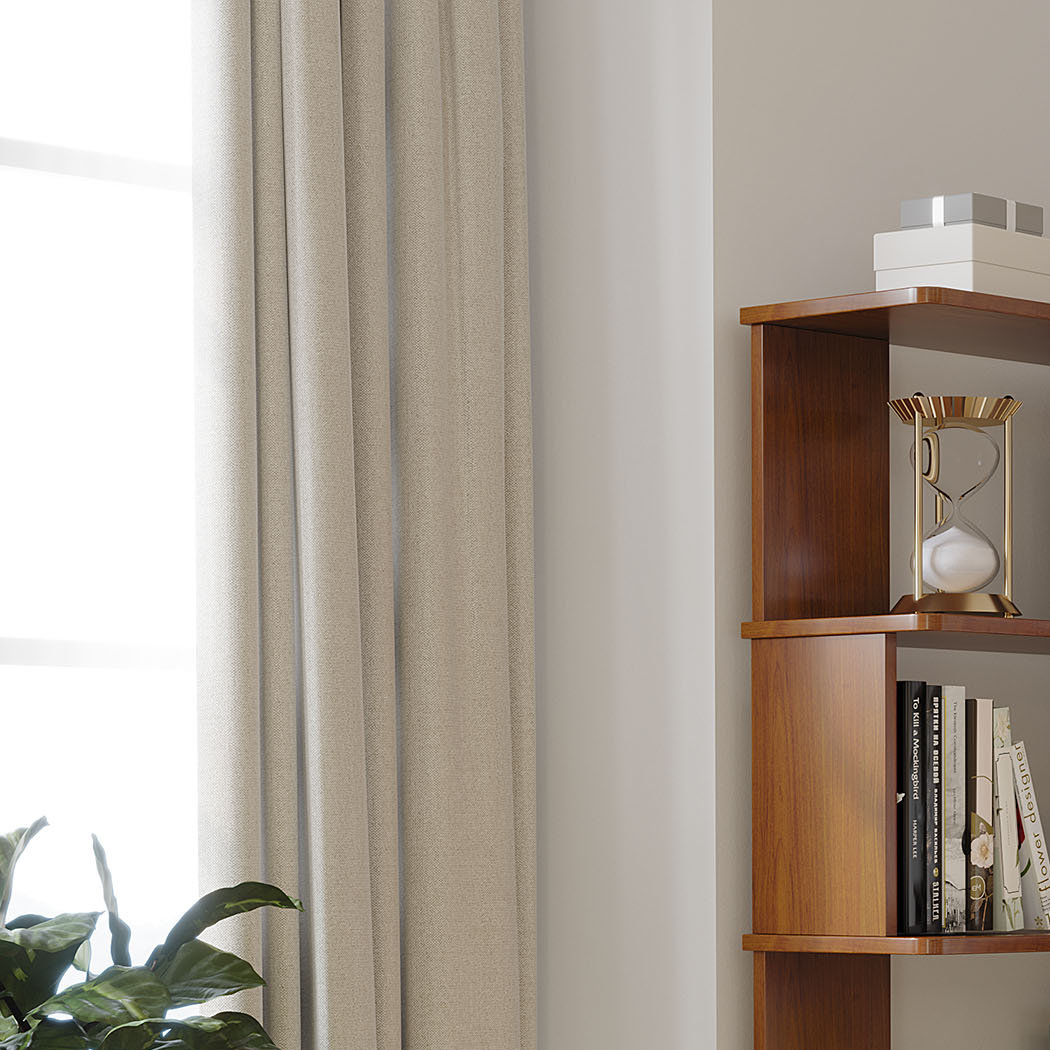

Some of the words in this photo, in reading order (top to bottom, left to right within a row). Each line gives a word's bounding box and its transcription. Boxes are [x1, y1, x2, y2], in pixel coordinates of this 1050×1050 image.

[911, 697, 920, 710] To
[911, 712, 920, 727] Kill
[911, 738, 920, 800] Mockingbird
[1015, 744, 1037, 824] designer
[1033, 832, 1050, 892] flower
